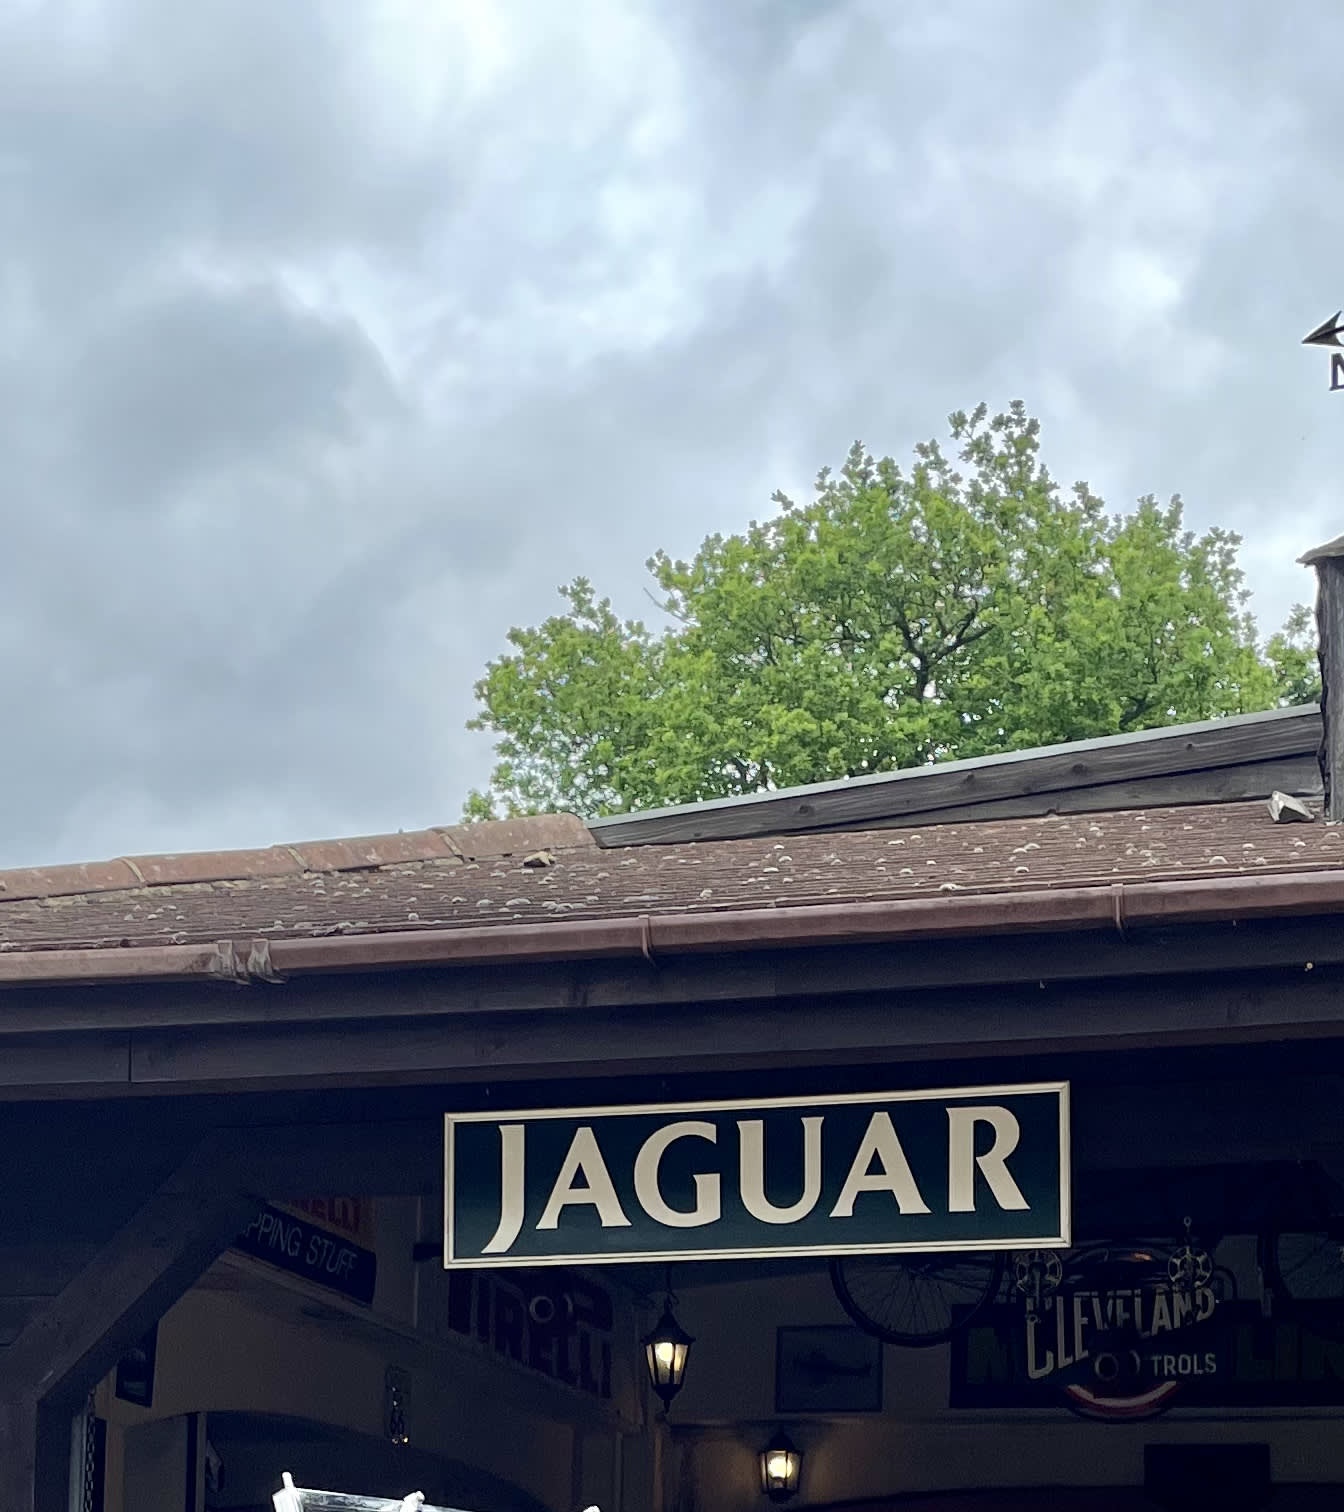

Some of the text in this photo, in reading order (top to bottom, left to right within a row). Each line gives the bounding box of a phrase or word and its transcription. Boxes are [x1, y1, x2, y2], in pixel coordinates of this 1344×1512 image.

[481, 1105, 1032, 1255] JAGUAR
[305, 1235, 359, 1280] STUFF
[1025, 1287, 1216, 1380] CLEVELAND
[1151, 1352, 1217, 1378] TROLS
